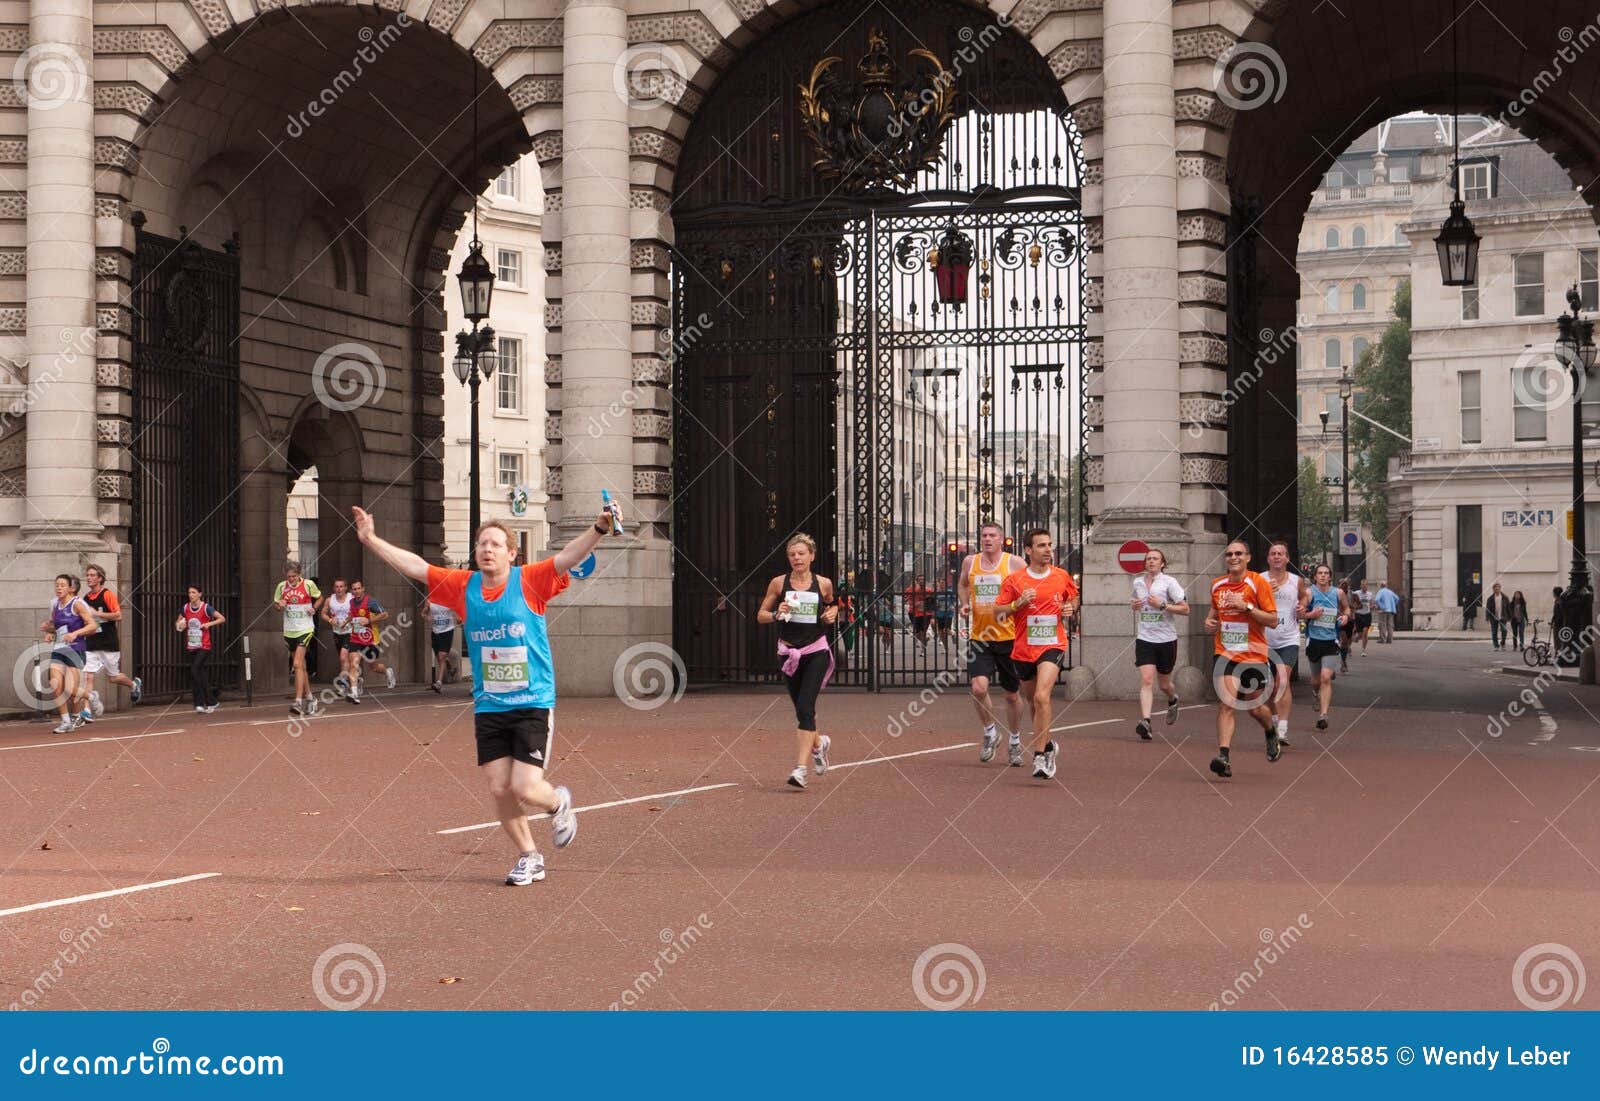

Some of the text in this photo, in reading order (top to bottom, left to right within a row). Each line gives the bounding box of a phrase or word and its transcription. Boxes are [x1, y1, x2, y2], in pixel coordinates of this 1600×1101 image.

[470, 623, 508, 642] unicef
[1031, 626, 1055, 637] 2486
[1222, 633, 1245, 641] 3902
[487, 664, 524, 680] 5626
